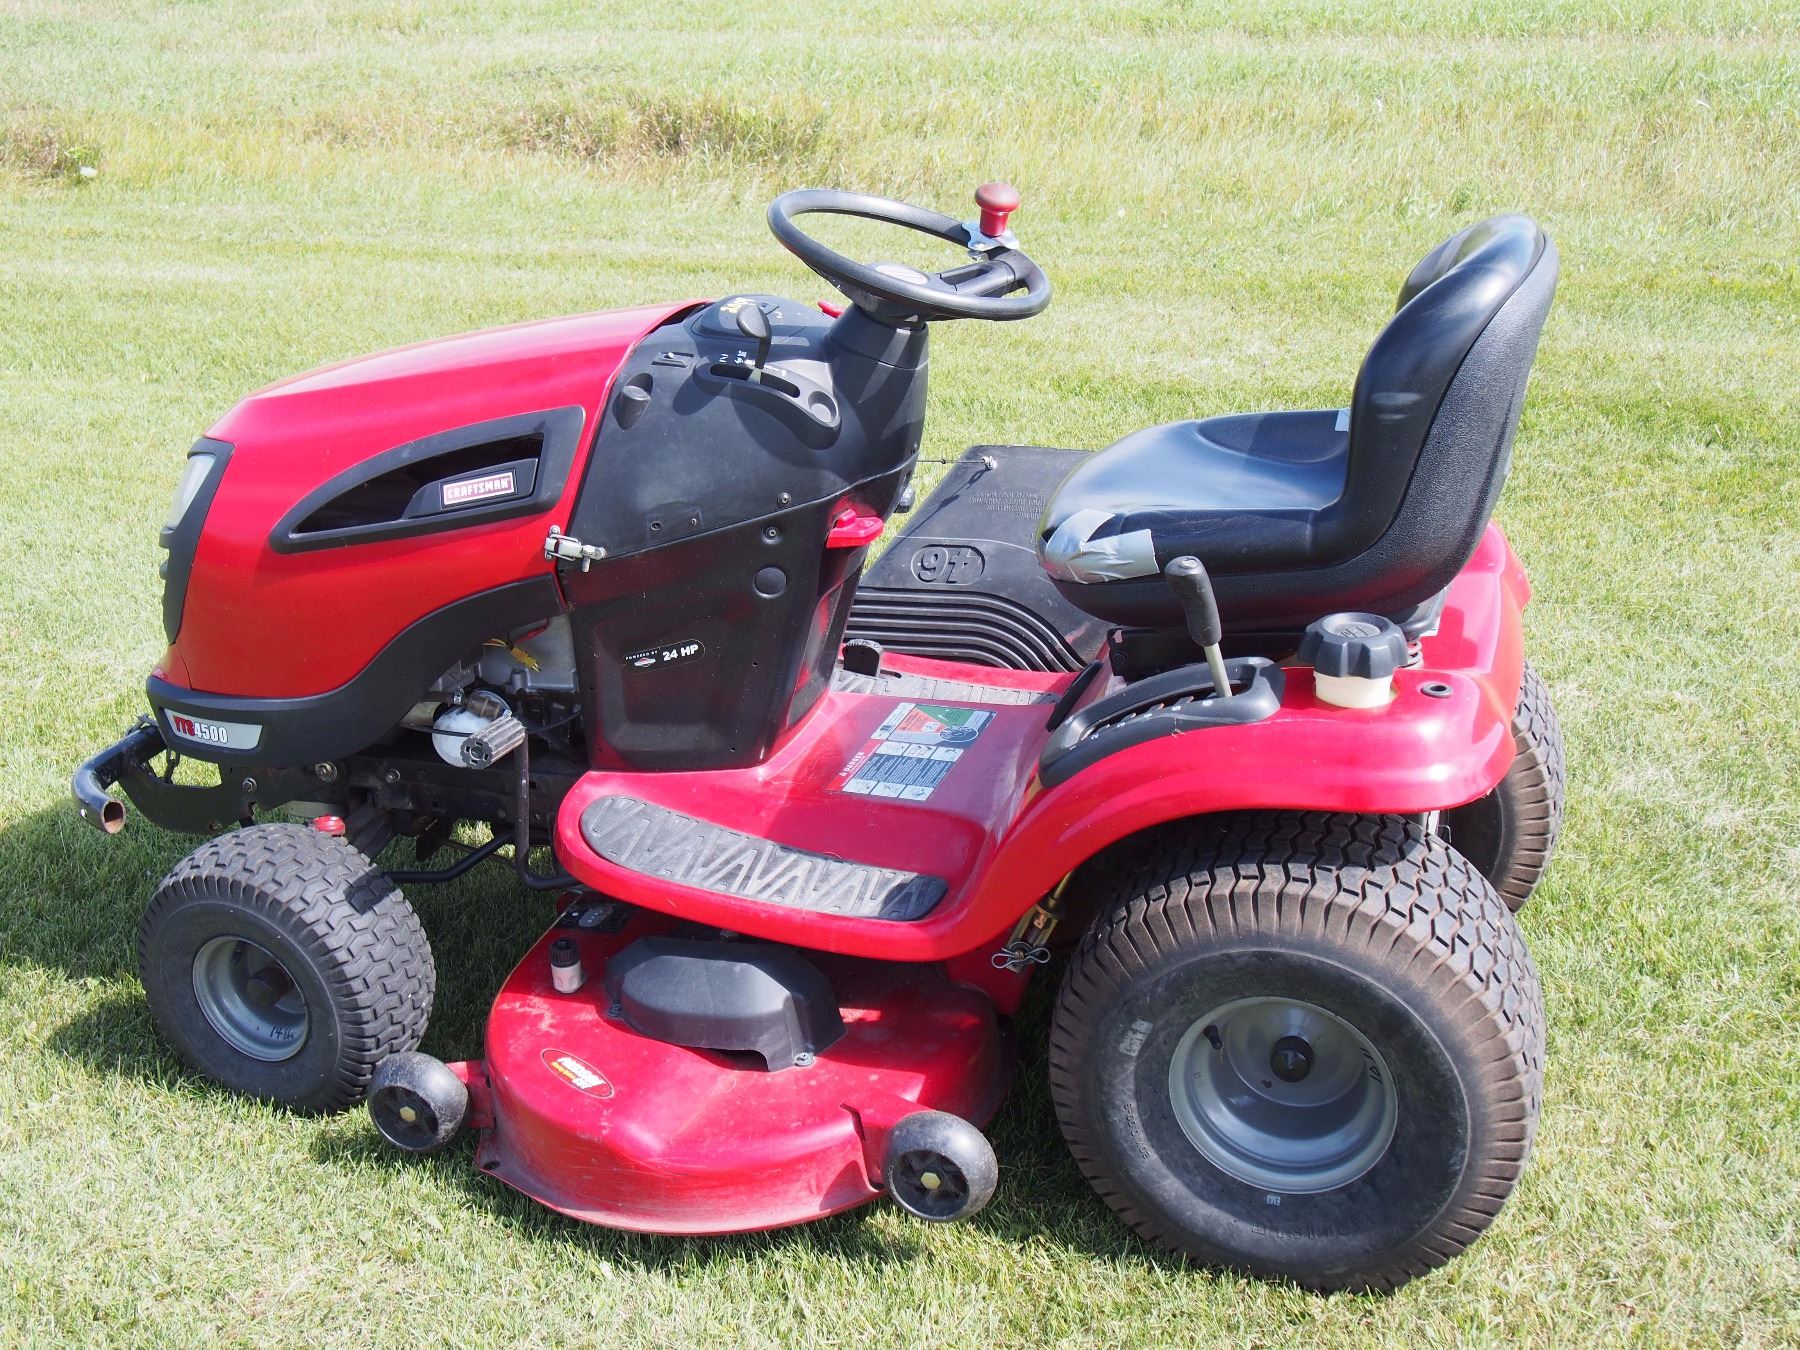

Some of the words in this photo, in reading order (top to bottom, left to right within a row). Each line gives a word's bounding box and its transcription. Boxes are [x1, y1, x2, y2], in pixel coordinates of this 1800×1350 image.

[447, 478, 509, 499] CRAFTSMAN
[662, 649, 679, 662] 24
[681, 644, 698, 657] HP
